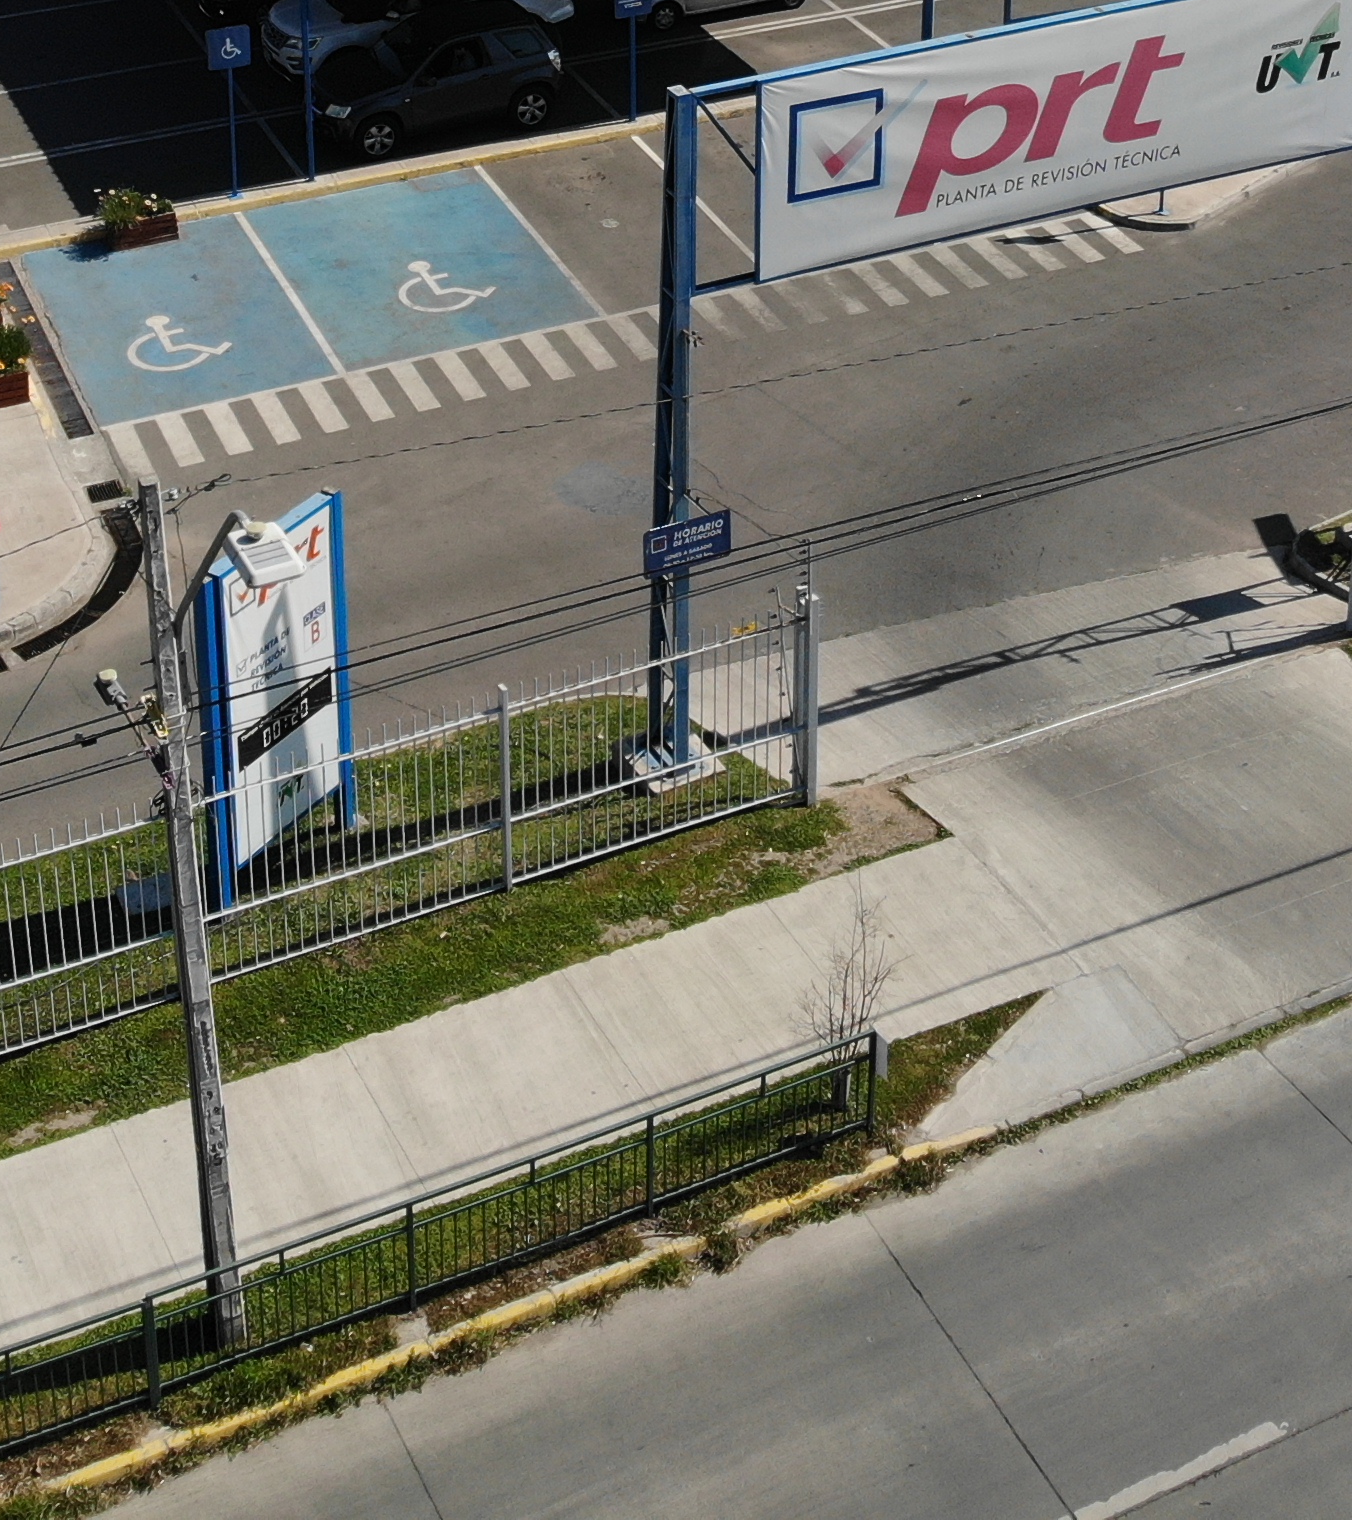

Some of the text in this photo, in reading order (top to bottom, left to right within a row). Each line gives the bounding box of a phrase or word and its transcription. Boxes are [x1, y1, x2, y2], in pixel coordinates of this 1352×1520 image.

[894, 35, 1185, 218] prt
[936, 147, 1181, 208] PLANTA DE REVISIÓN TÉCNICA
[674, 519, 723, 540] HORARIO
[673, 540, 683, 548] DE
[311, 620, 321, 645] B
[250, 637, 279, 663] PLANTA
